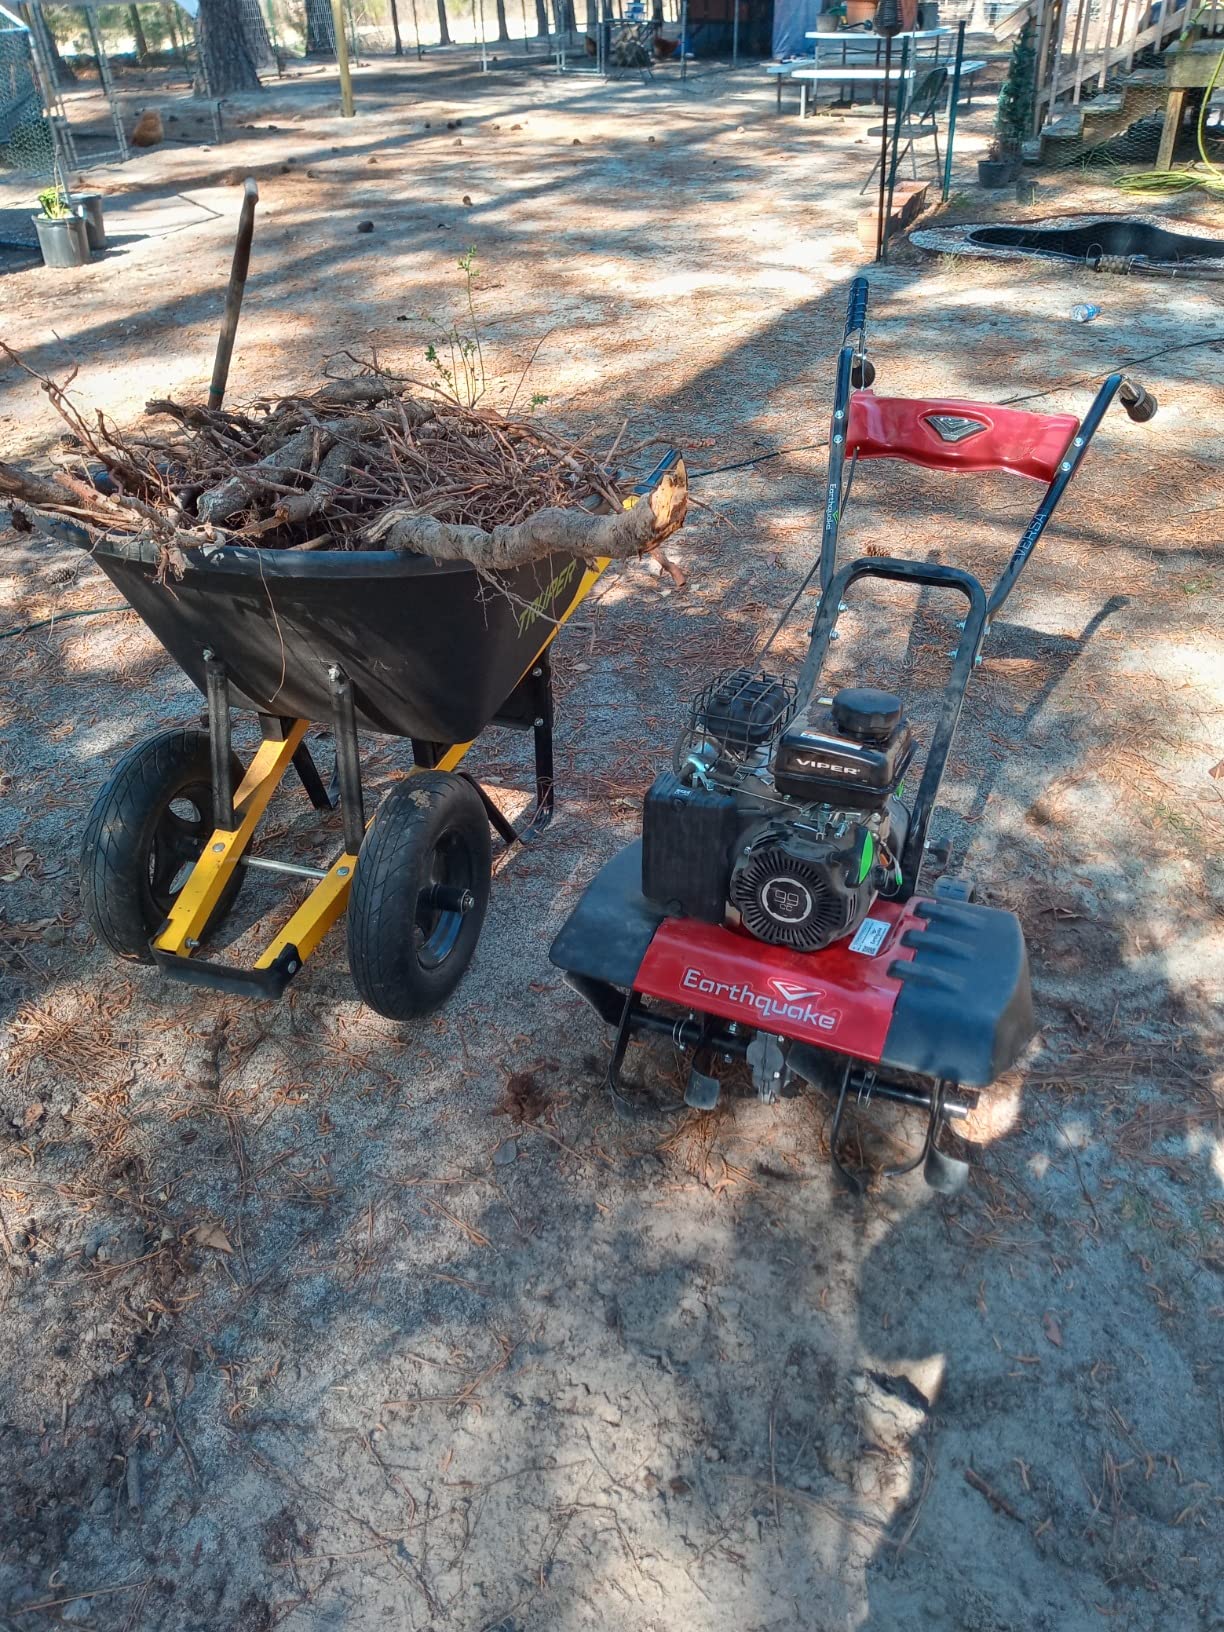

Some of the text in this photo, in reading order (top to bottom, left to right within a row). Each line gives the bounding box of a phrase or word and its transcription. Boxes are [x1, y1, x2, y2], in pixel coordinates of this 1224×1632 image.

[826, 483, 837, 531] Earthquake
[1013, 513, 1047, 556] VERSA
[796, 758, 858, 775] VIPER
[774, 889, 799, 907] 99
[683, 968, 836, 1030] Earthquake
